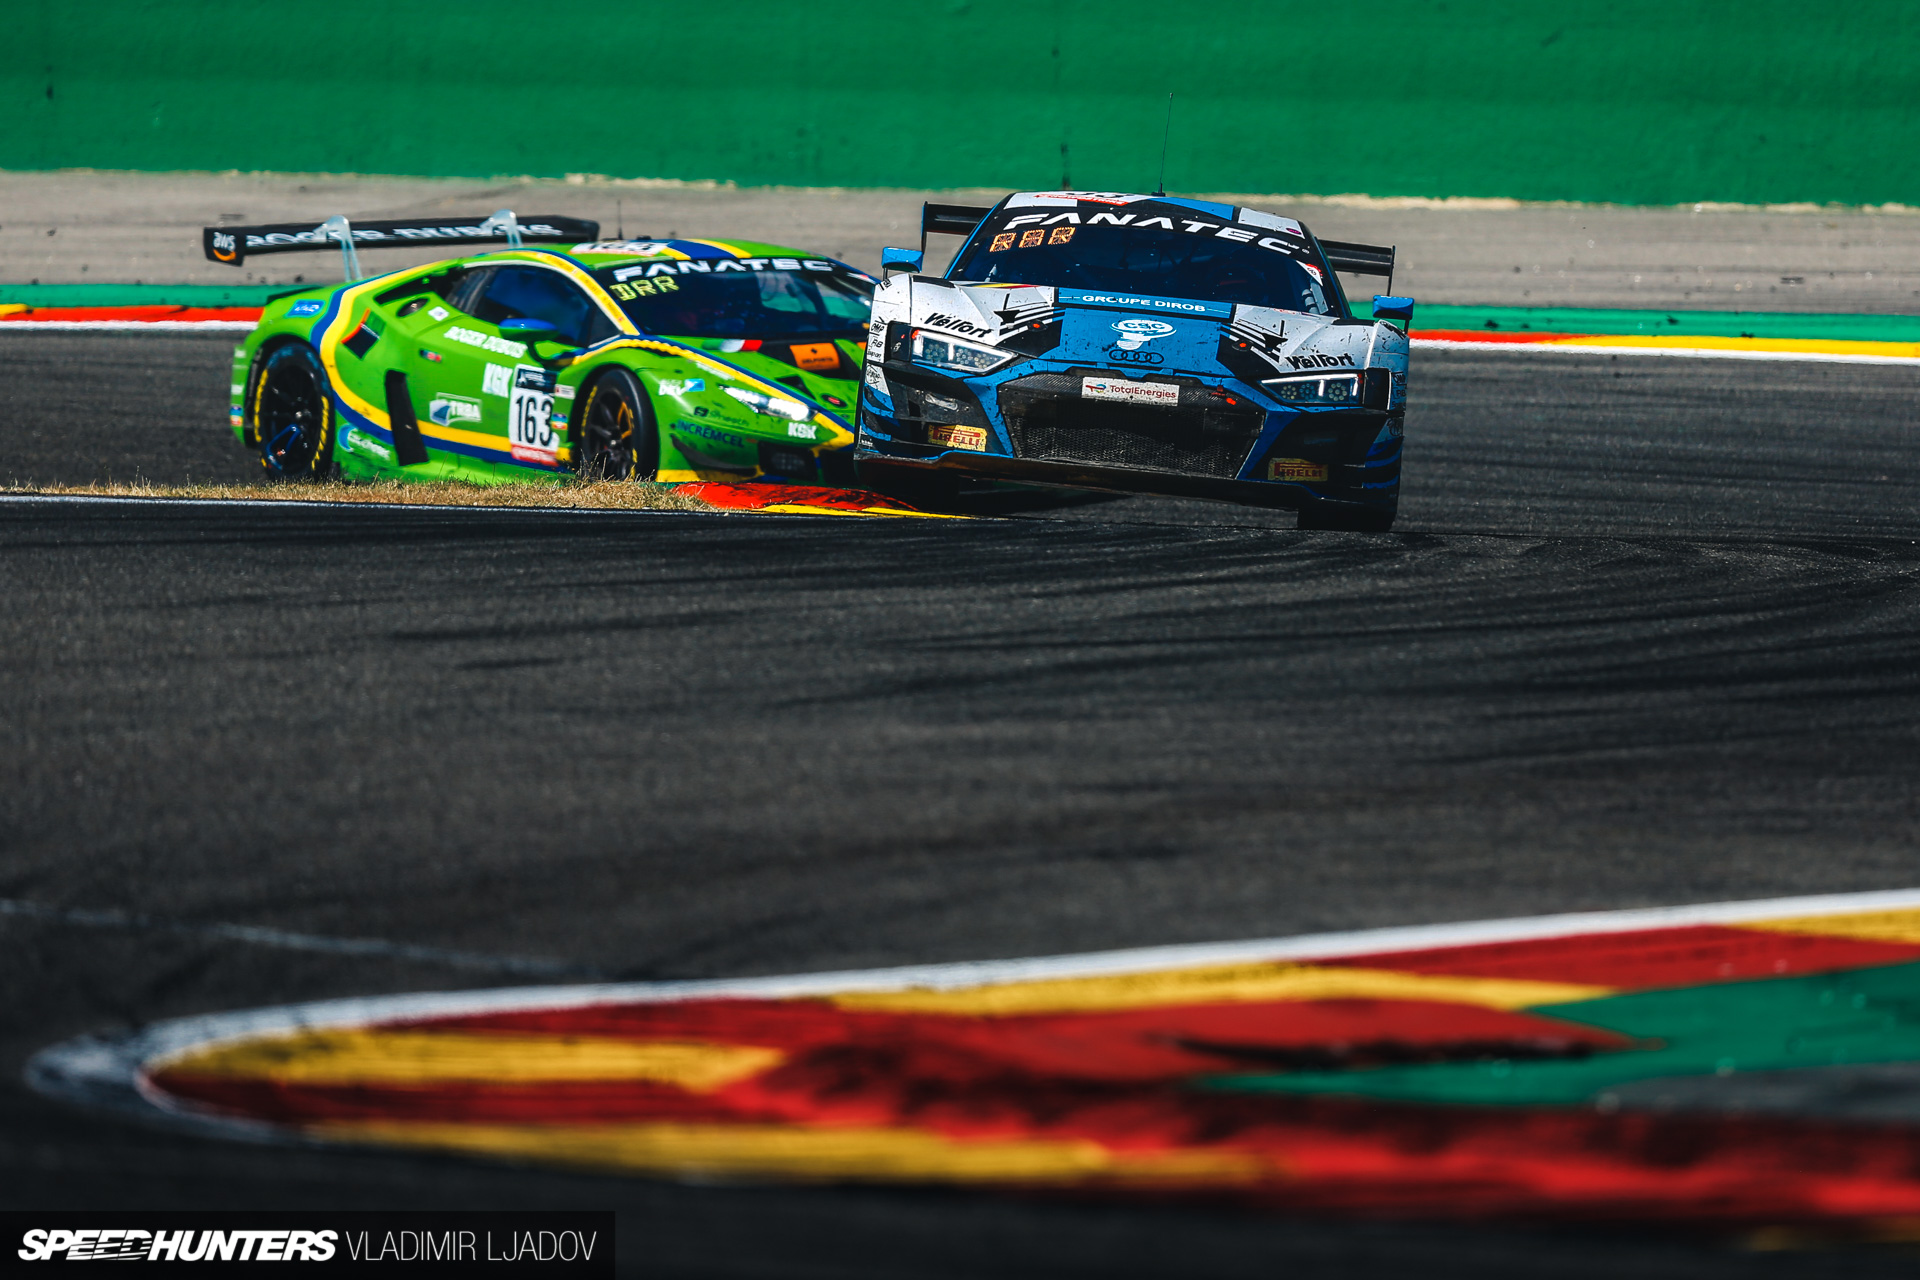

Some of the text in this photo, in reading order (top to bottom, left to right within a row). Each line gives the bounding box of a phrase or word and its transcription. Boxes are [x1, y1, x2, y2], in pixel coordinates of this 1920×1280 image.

[1003, 212, 1299, 255] FANATEC
[612, 258, 834, 282] FANATEC
[1082, 295, 1206, 312] GROUPE DIROB
[1110, 385, 1177, 399] TotalEnergies
[516, 395, 553, 447] 163
